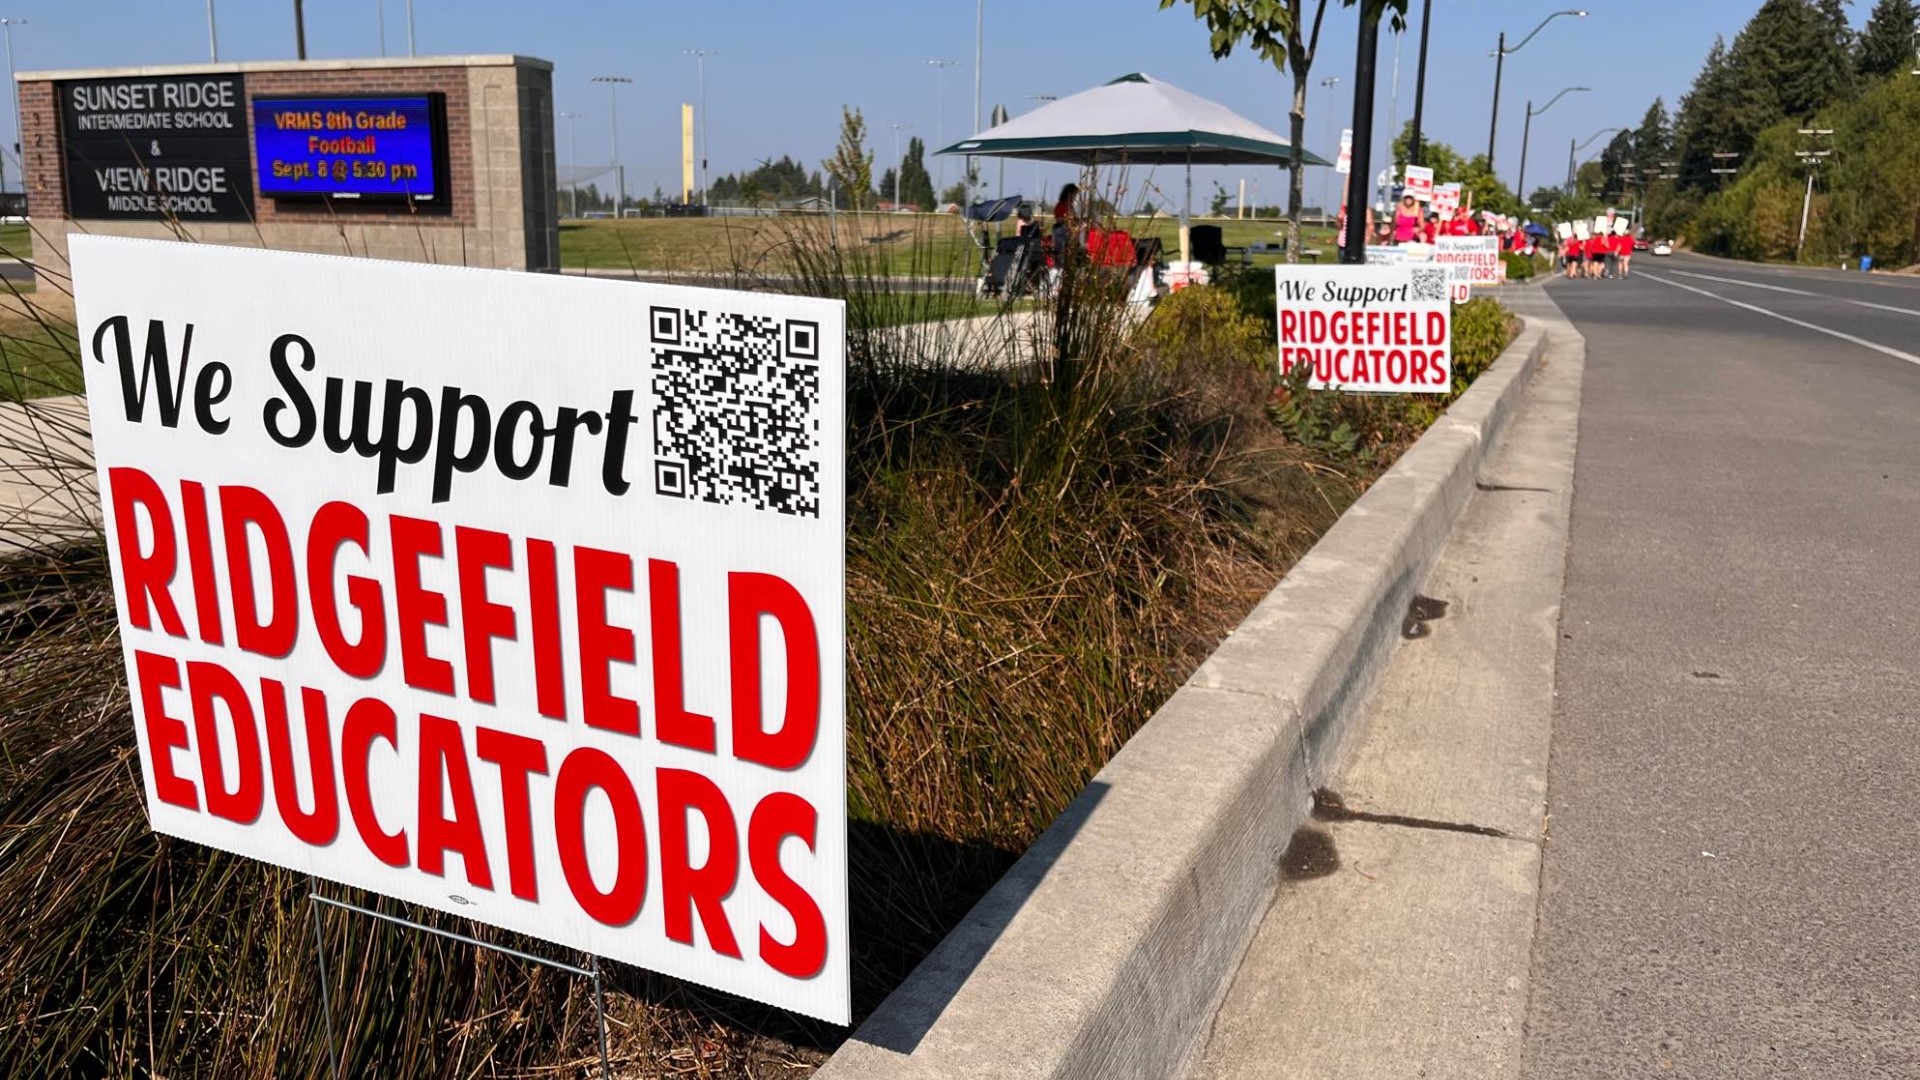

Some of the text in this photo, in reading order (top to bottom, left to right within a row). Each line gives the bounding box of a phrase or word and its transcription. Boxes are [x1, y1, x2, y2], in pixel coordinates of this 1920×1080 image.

[73, 82, 236, 111] SUNSET RIDGE
[78, 111, 233, 130] INTERMEDIATE SCHOOL
[274, 111, 407, 129] VRMS 8th Grade
[150, 140, 162, 156] &
[309, 136, 376, 154] Football
[95, 167, 227, 193] VIEW RIDGE
[272, 160, 314, 180] Sept.
[332, 160, 348, 180] @
[352, 161, 386, 177] 5:30
[391, 167, 417, 181] pm
[108, 196, 157, 212] MIDDLE
[1280, 280, 1408, 308] We Support
[1281, 310, 1446, 346] RIDGEFIELD
[92, 315, 639, 504] We Support
[108, 466, 821, 771] RIDGEFIELD
[134, 649, 829, 980] EDUCATORS
